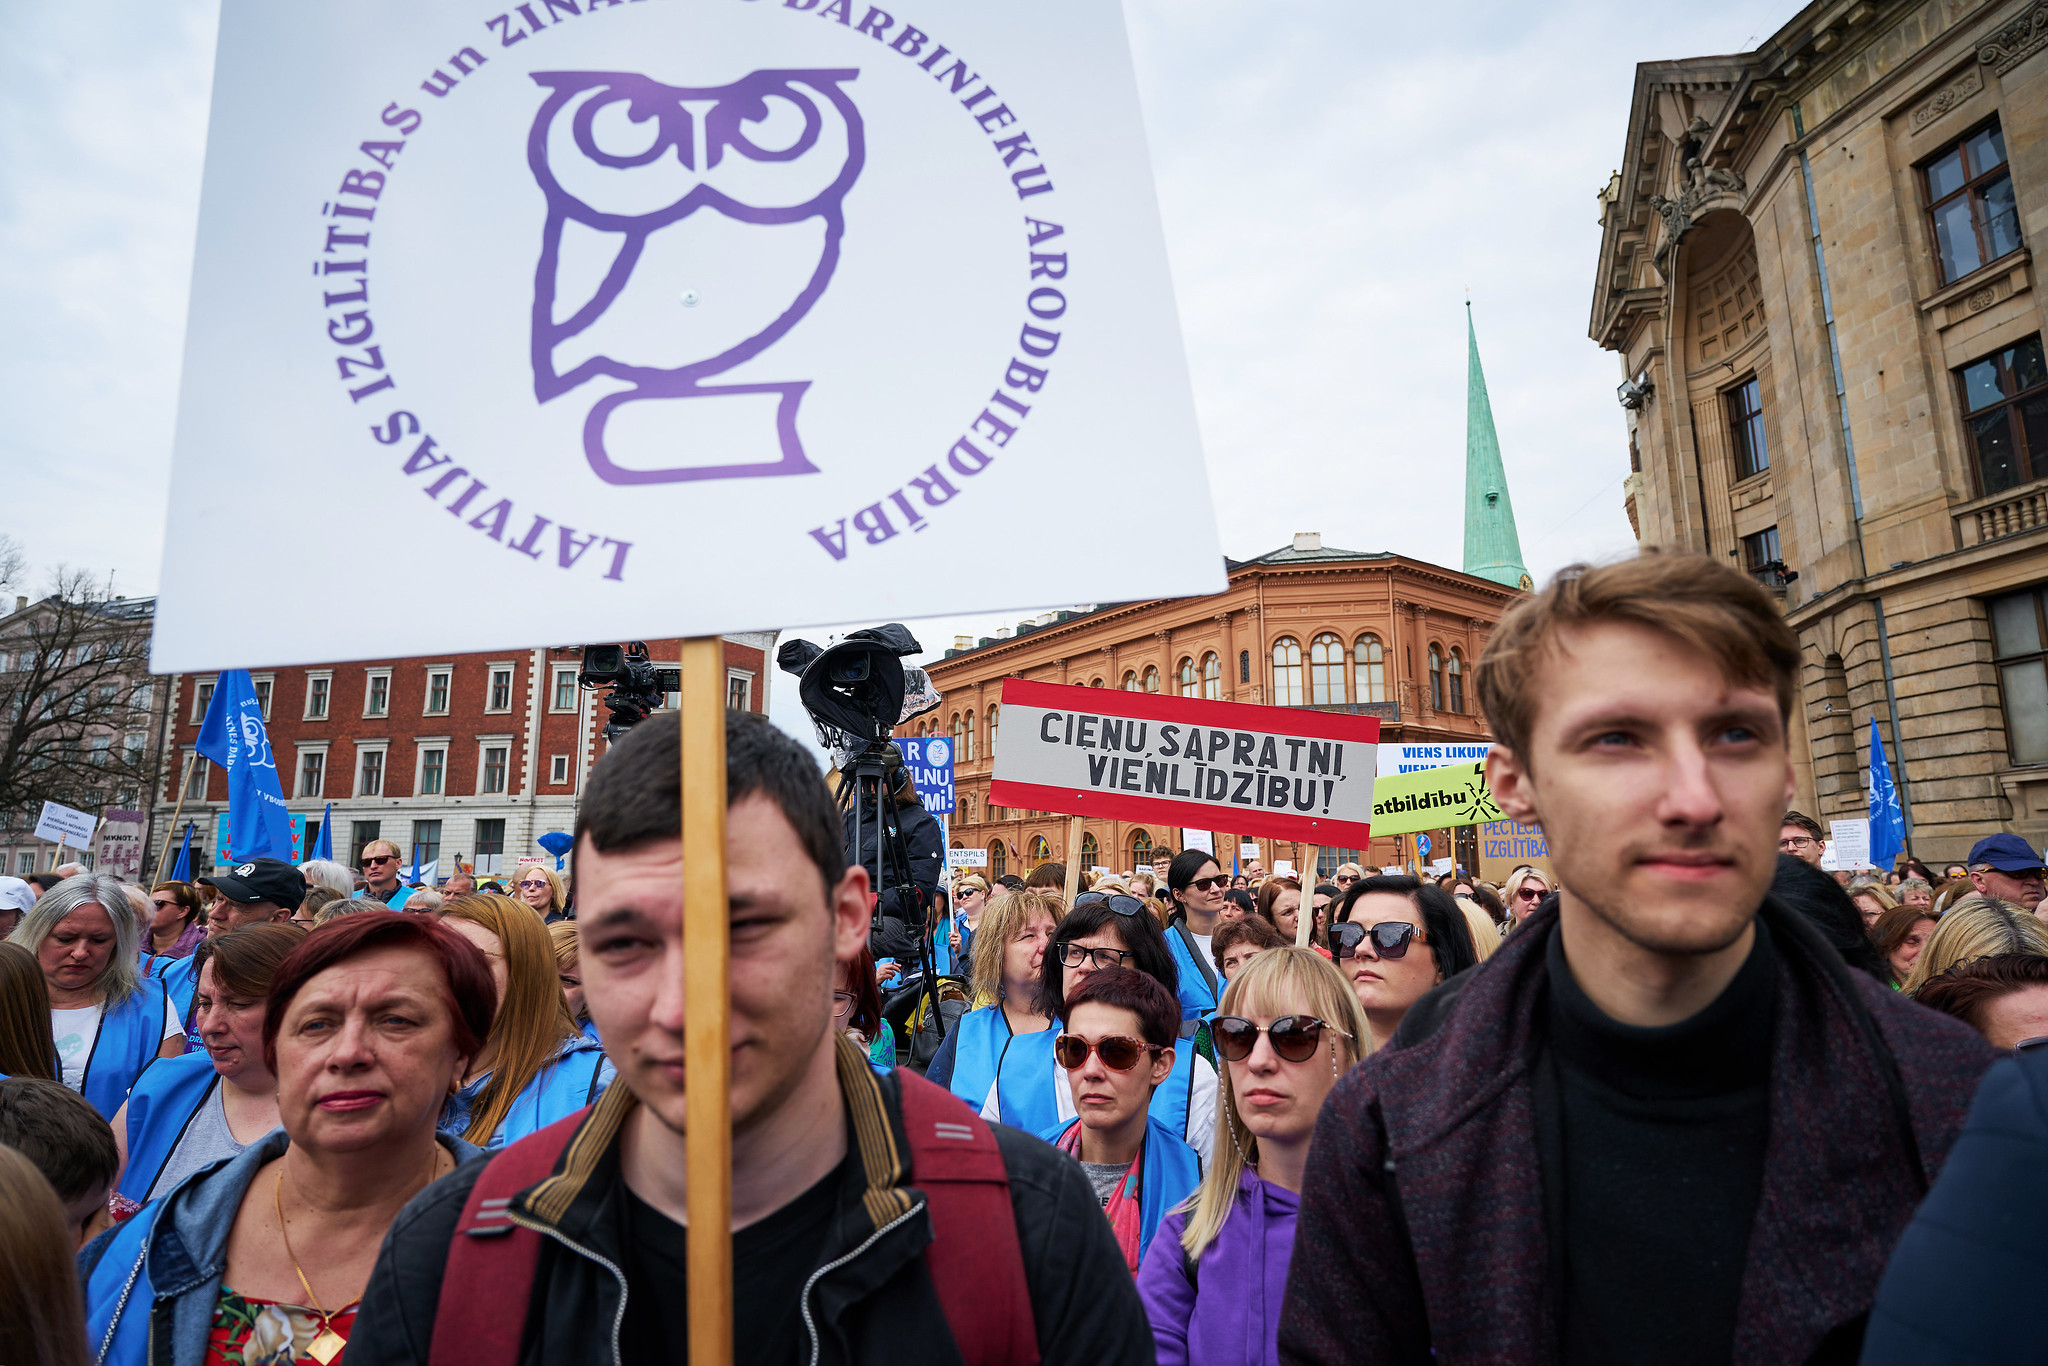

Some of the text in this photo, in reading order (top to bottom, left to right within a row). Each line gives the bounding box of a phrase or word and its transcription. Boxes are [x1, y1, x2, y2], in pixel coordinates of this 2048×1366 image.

[420, 47, 488, 98] un
[313, 101, 422, 404] IZGLĪTĪBAS
[807, 216, 1068, 561] ARODBIEDRĪBA
[370, 410, 634, 581] LATVIJAS
[1159, 724, 1347, 782] SAPRATNI,
[1402, 746, 1489, 759] VIENS LIKUM
[1088, 753, 1336, 815] VIENLĪDZĪBU!
[1373, 790, 1467, 816] atbildību
[949, 850, 985, 858] ENTSPILS
[1484, 837, 1550, 858] IZGLĪTĪBĀ
